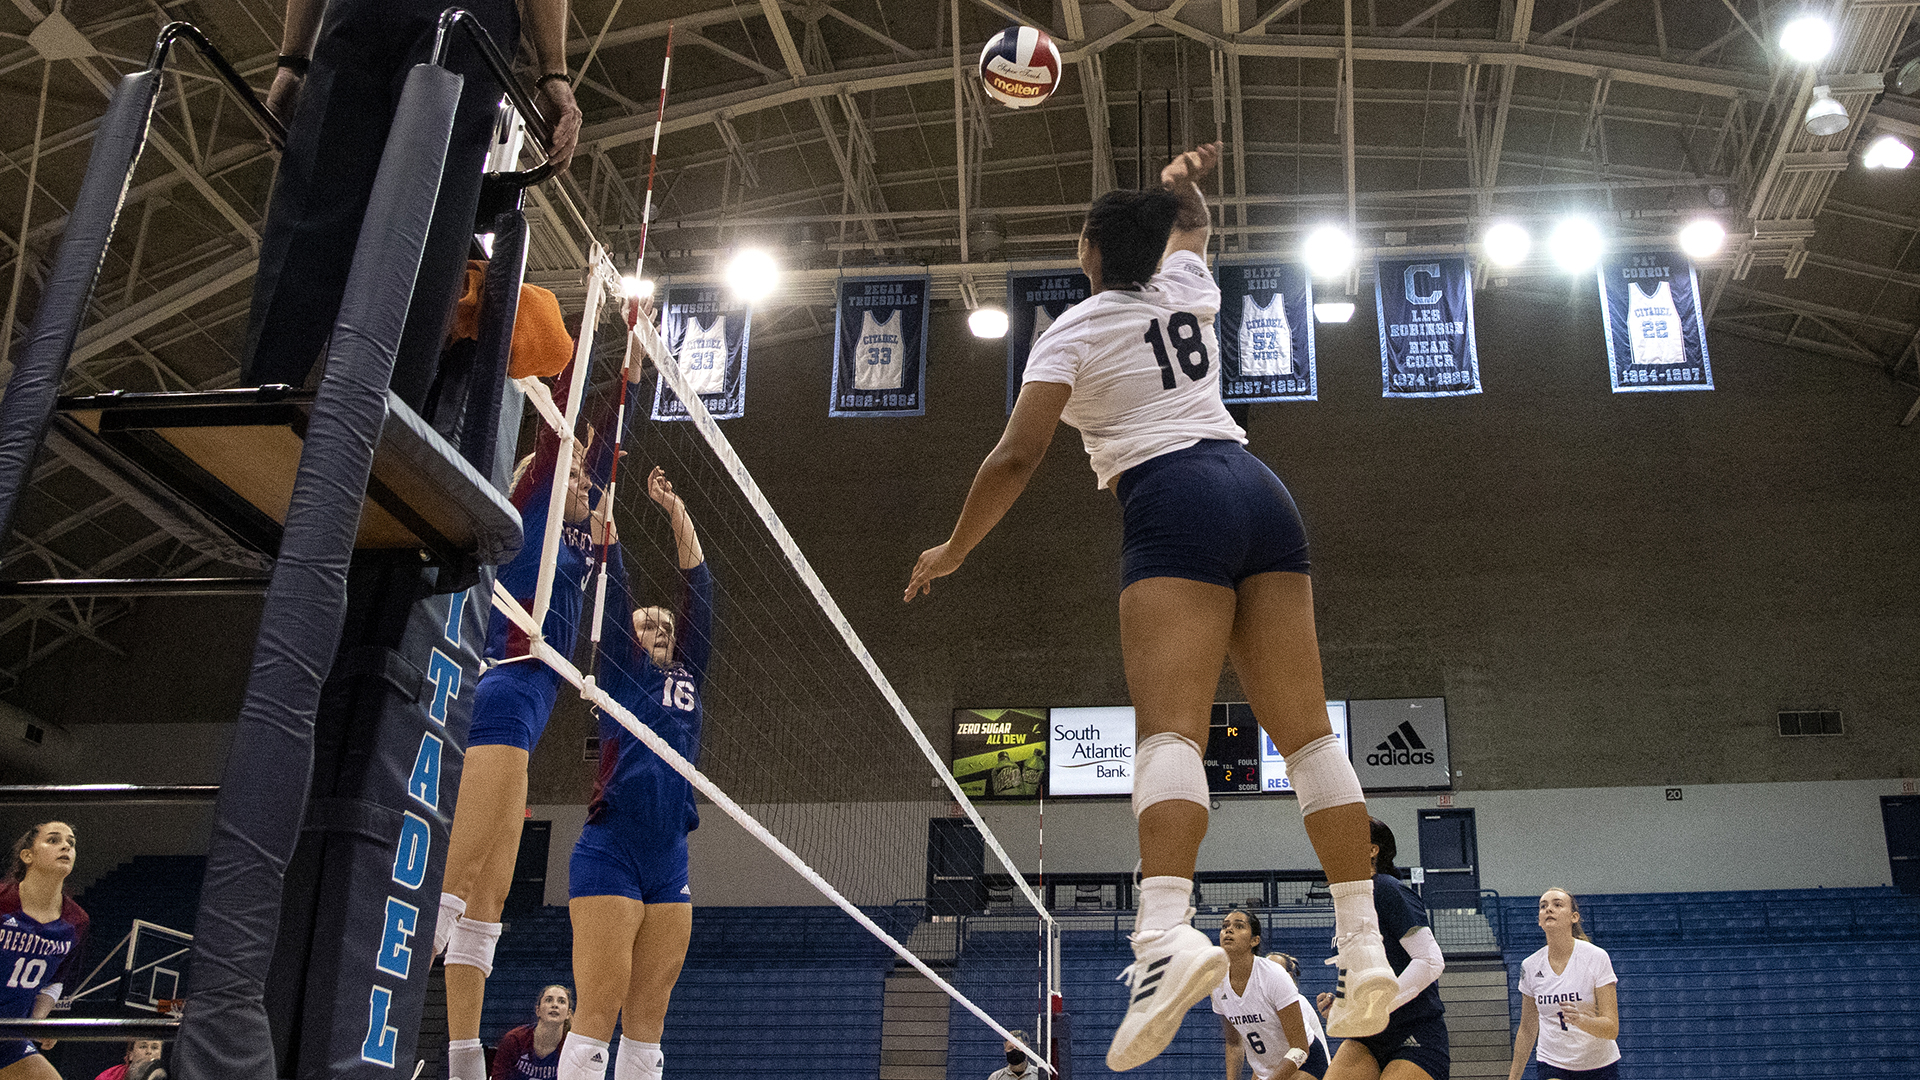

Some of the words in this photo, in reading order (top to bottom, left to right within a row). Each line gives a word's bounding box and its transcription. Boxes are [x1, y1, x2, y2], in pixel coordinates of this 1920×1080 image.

[997, 62, 1017, 75] Super
[1019, 69, 1041, 79] Touch
[993, 76, 1041, 96] molten
[1633, 255, 1657, 267] PAT
[1243, 266, 1281, 279] BLITZ
[1622, 266, 1670, 279] CONROY
[864, 284, 904, 295] REGAN
[1040, 278, 1071, 290] JAKE
[1247, 279, 1278, 290] KIDS
[1403, 263, 1443, 305] C
[848, 294, 918, 306] TRUESDALE
[1026, 289, 1085, 302] BURROWS
[1411, 309, 1441, 322] LES
[1634, 306, 1673, 318] CITADEL
[1245, 318, 1283, 330] CITADEL
[1390, 321, 1465, 337] ROBINSON
[1642, 320, 1669, 339] 22
[862, 333, 899, 345] CITADEL
[1252, 331, 1277, 351] 57
[1143, 311, 1210, 391] 18
[1409, 340, 1450, 354] HEAD
[691, 351, 715, 371] 33
[867, 347, 892, 366] 33
[1405, 354, 1455, 369] COACH
[662, 676, 695, 712] 16
[957, 722, 981, 735] ZERO
[981, 722, 1012, 734] SUGAR
[1054, 724, 1100, 741] South
[1227, 727, 1239, 737] PC
[986, 735, 1001, 745] ALL
[1003, 733, 1027, 745] DEW
[1072, 742, 1132, 759] Atlantic
[1366, 748, 1435, 767] adidas
[1238, 758, 1258, 766] FOULS
[1225, 769, 1233, 782] 2
[1246, 767, 1255, 782] 2
[1667, 789, 1682, 800] 20
[361, 587, 471, 1069] ITADEL
[6, 956, 48, 989] 10
[1537, 991, 1583, 1005] CITADEL
[1228, 1013, 1266, 1026] CITADEL
[1246, 1031, 1267, 1055] 6
